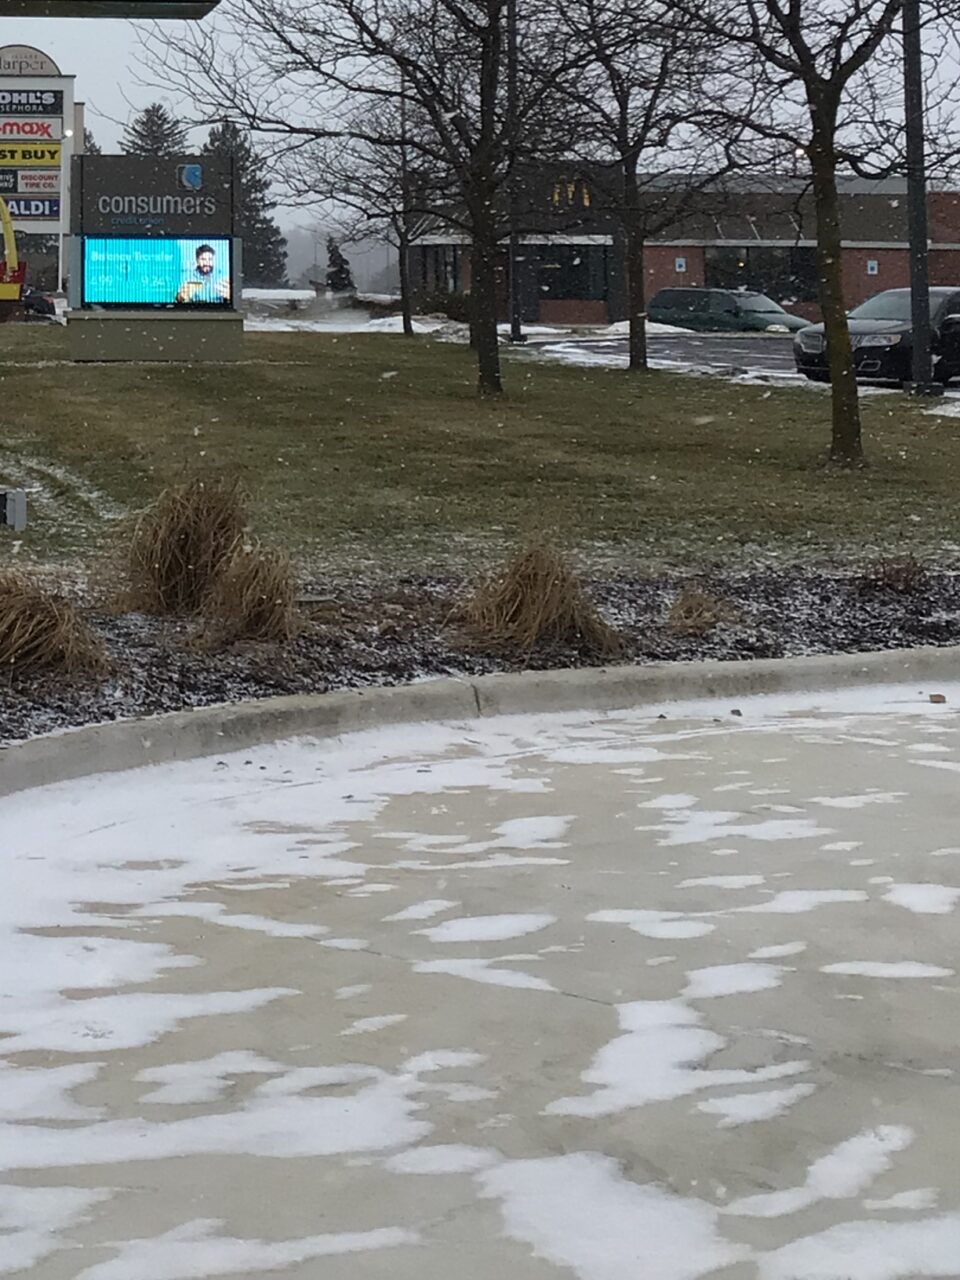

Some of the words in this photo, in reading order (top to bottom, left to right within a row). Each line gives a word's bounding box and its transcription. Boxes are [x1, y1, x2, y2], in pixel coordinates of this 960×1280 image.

[21, 150, 59, 160] BUY
[7, 201, 50, 215] ALDI
[98, 195, 216, 215] consumers
